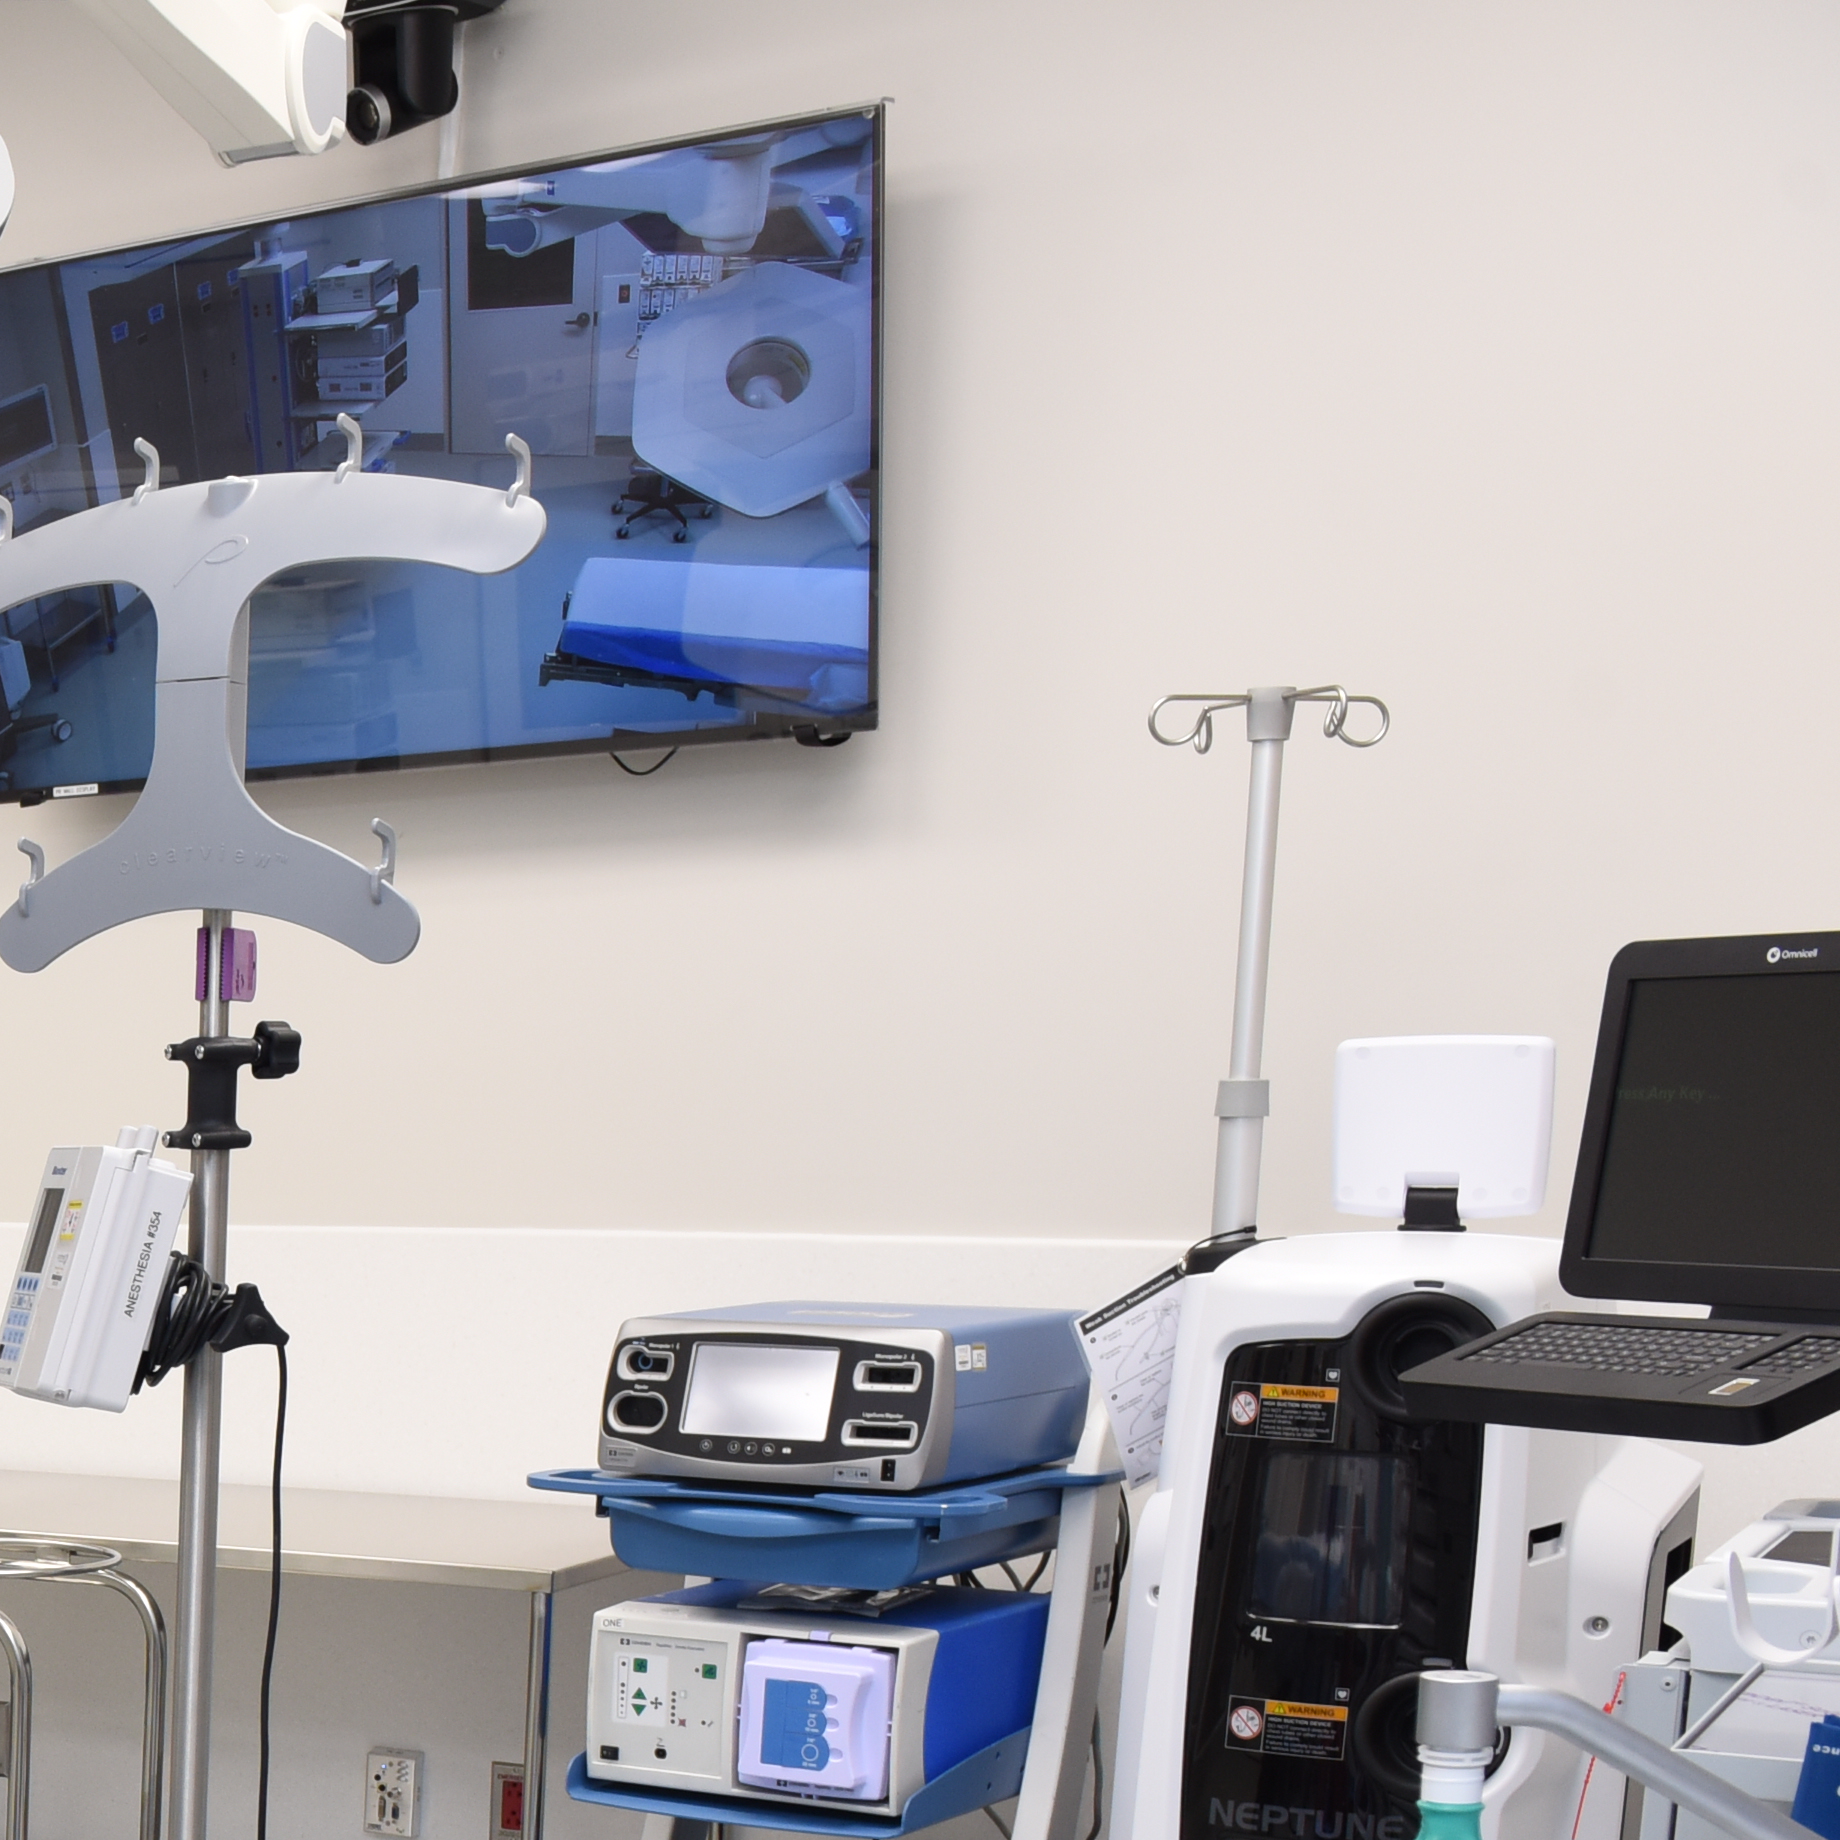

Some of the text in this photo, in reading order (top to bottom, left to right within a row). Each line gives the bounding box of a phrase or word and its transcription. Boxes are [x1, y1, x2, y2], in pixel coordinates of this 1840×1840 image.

[1781, 948, 1818, 960] Omnicell
[1679, 1086, 1704, 1103] Key
[52, 1165, 68, 1176] Baxter
[123, 1210, 163, 1318] ANESTHESIA #354
[1103, 1300, 1127, 1319] Suction
[1126, 1274, 1175, 1305] Troubleshooting
[1281, 1388, 1326, 1399] WARNING
[602, 1618, 623, 1628] ONE
[1250, 1625, 1273, 1643] 4L
[1288, 1705, 1336, 1717] WARNING
[1283, 1718, 1309, 1726] SUCTION
